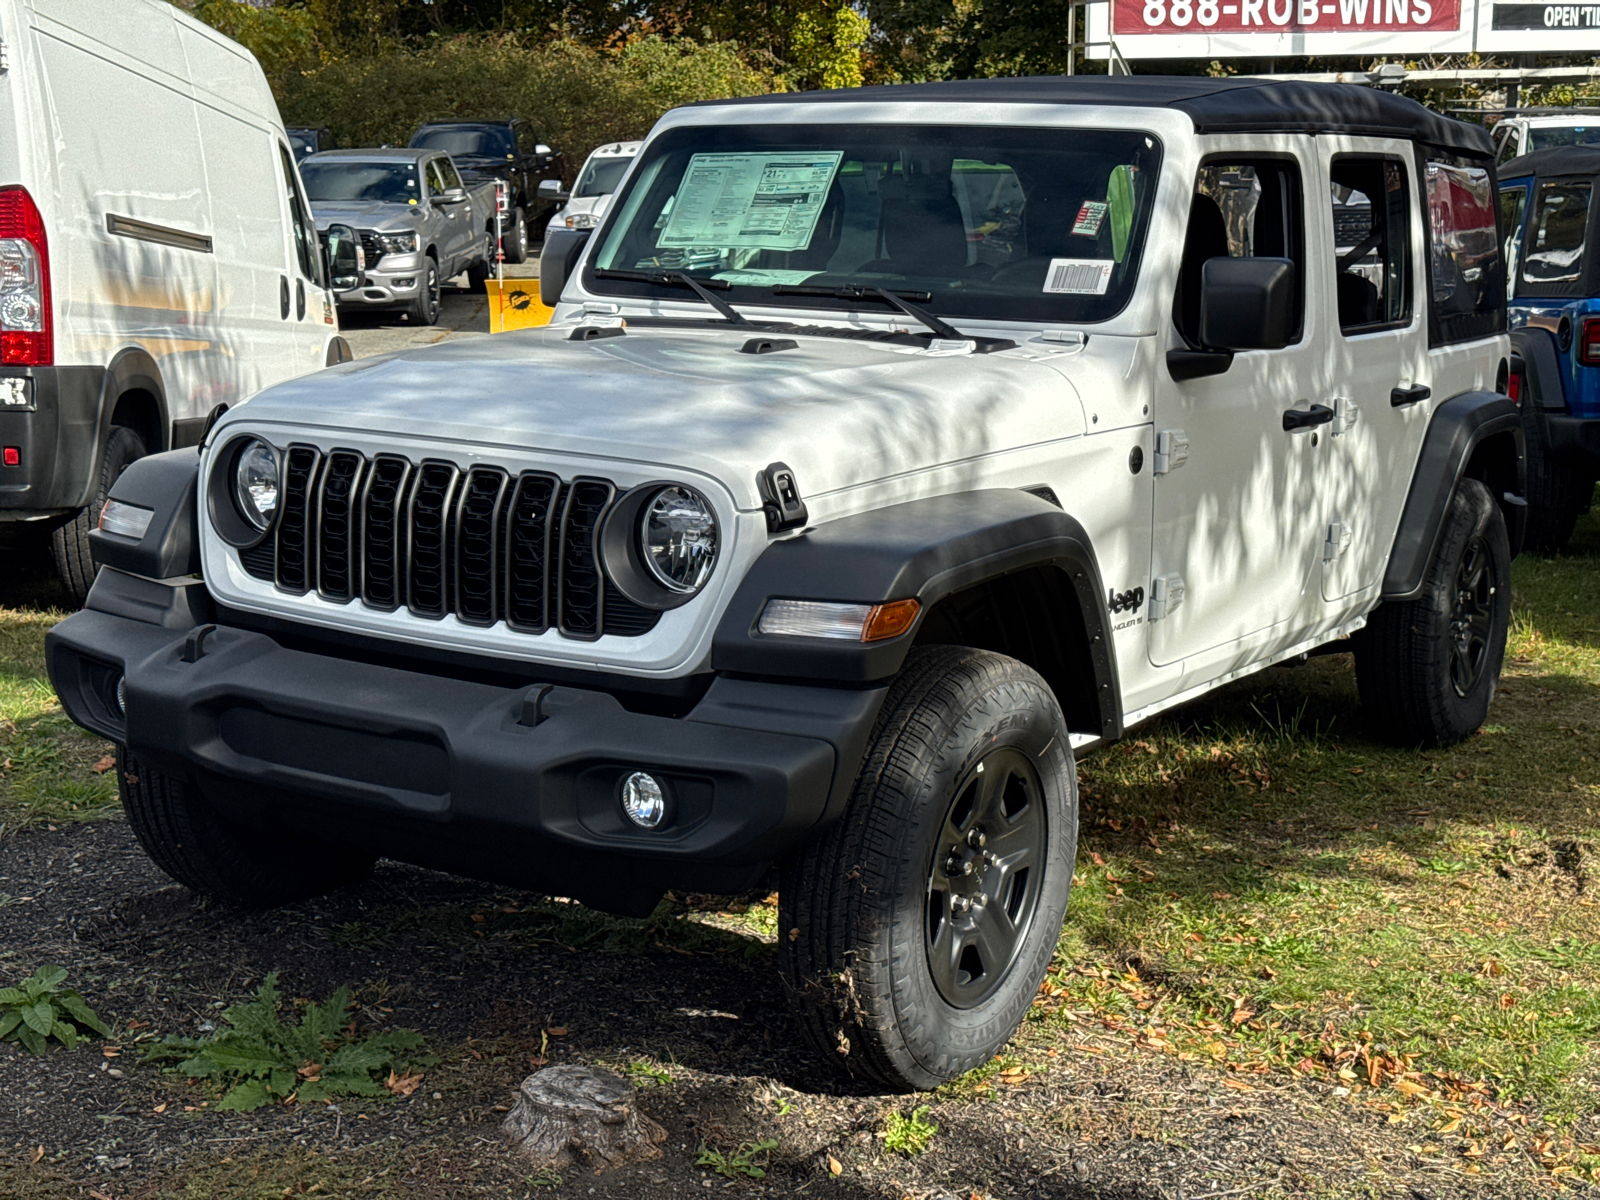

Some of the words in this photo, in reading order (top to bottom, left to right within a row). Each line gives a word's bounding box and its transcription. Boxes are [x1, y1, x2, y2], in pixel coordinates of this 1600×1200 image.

[1143, 0, 1432, 26] 888-ROB-WINS
[1544, 6, 1579, 27] OPEN
[766, 170, 777, 178] 21
[1108, 586, 1144, 614] Jeep
